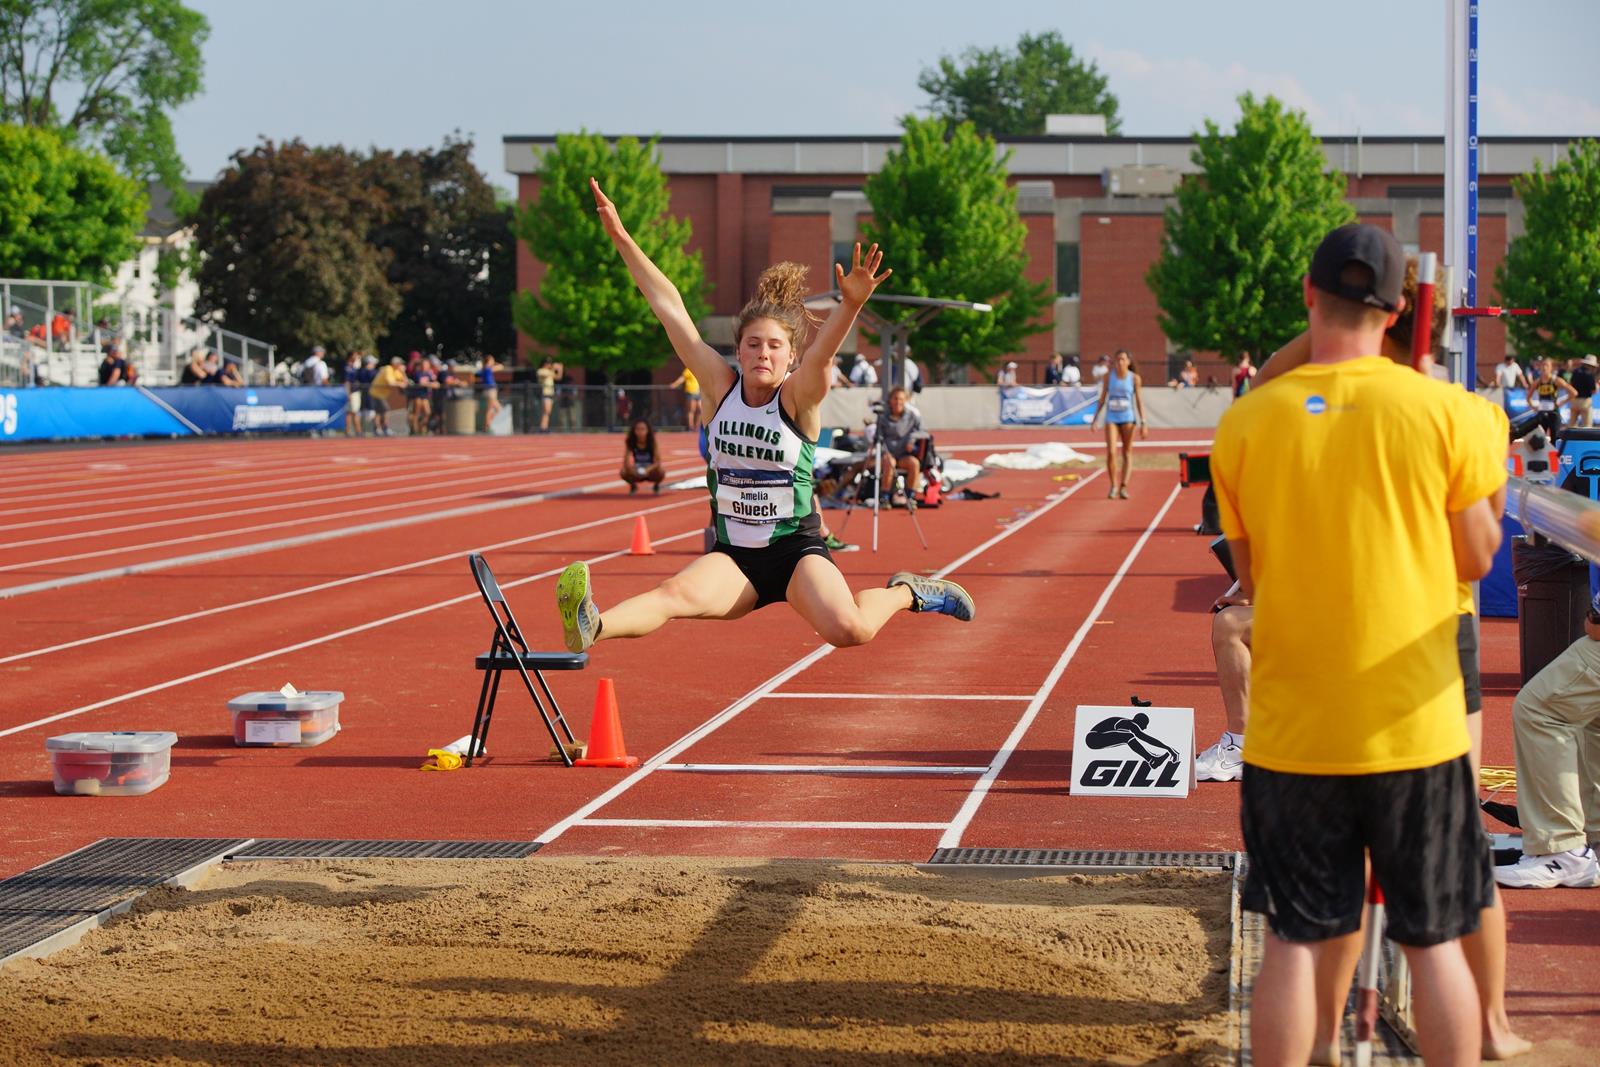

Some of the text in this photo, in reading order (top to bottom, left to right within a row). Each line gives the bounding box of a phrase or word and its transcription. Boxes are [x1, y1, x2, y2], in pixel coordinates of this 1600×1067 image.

[1469, 135, 1478, 149] 10
[1468, 225, 1477, 235] 8
[1468, 269, 1477, 279] 7
[719, 421, 781, 446] ILLINOIS
[714, 437, 784, 462] WESLEYAN
[740, 491, 769, 501] Amelia
[732, 501, 777, 516] Glueck
[1080, 760, 1181, 787] GILL
